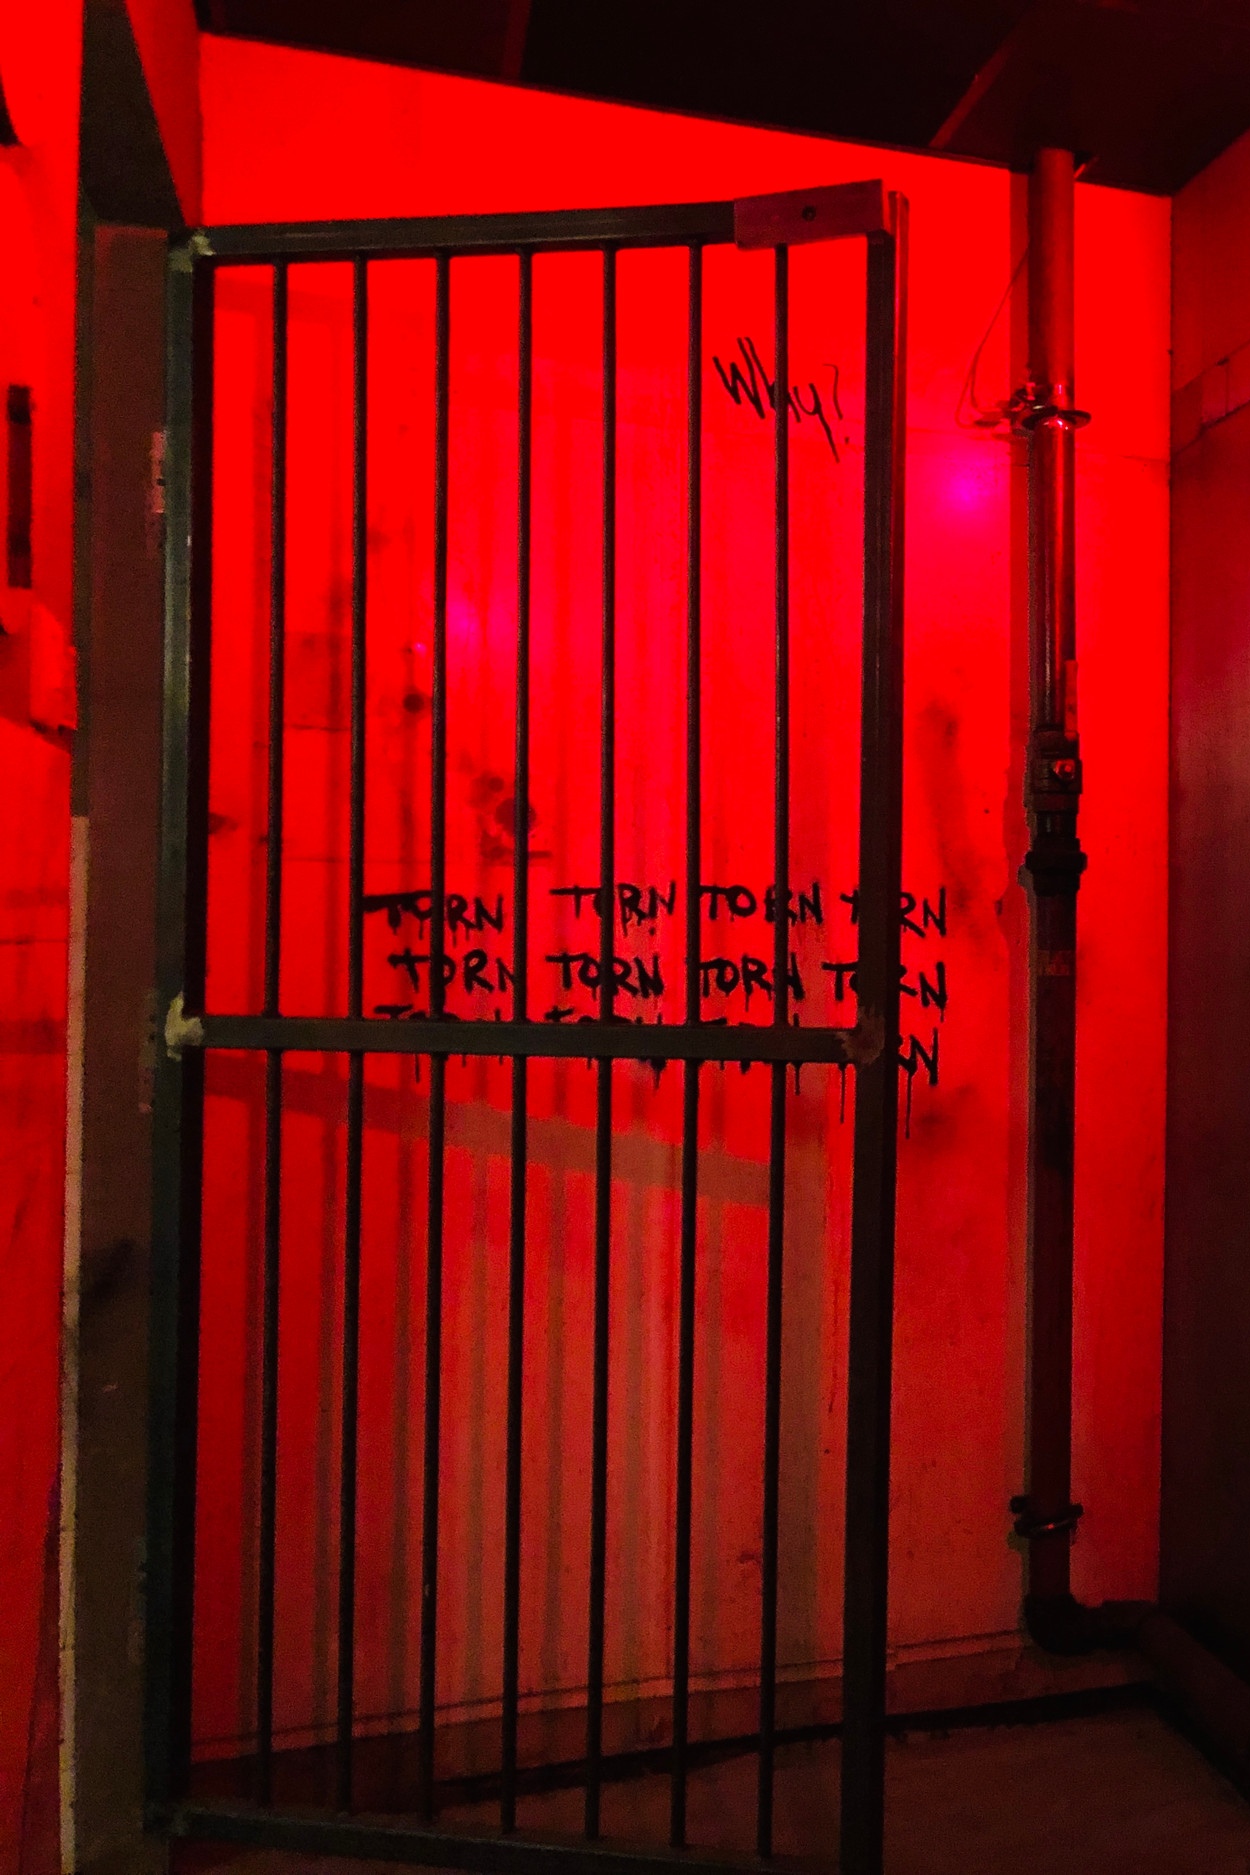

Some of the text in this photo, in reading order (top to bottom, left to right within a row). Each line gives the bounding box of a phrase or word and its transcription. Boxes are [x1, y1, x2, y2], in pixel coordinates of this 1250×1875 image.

[712, 337, 849, 463] Why?
[362, 889, 504, 942] TORN
[840, 886, 946, 938] TRN
[545, 951, 664, 1000] TORN
